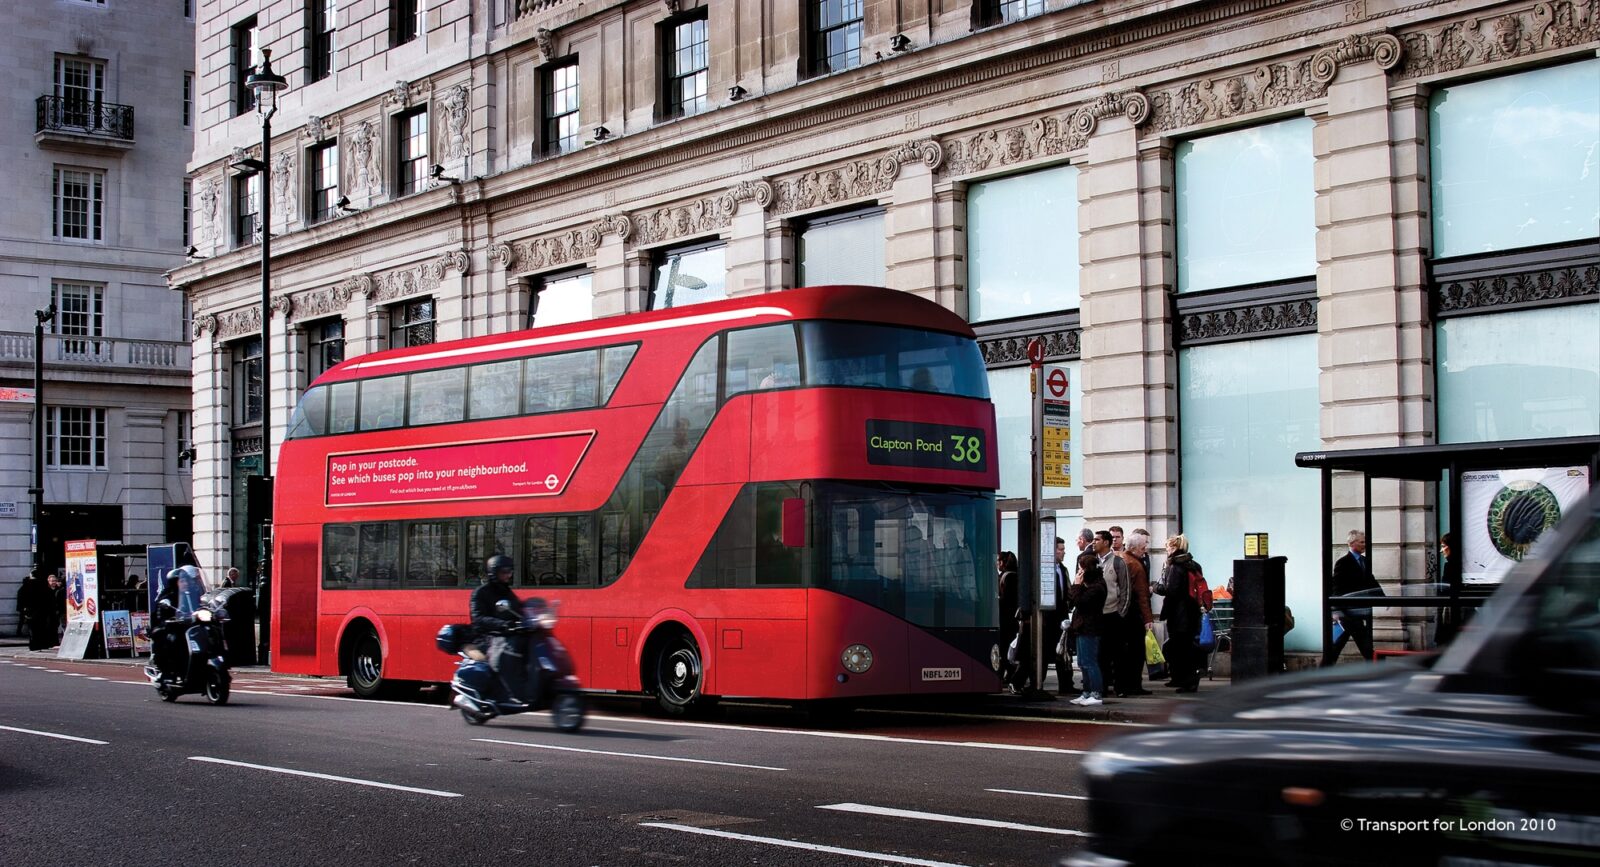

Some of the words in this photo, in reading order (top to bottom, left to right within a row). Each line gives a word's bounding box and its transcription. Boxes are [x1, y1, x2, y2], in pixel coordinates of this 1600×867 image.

[1034, 344, 1041, 360] J
[870, 436, 912, 452] Clapton
[916, 439, 943, 452] Pond
[950, 435, 981, 464] 38
[332, 462, 347, 474] Pop
[348, 461, 356, 470] in
[358, 461, 376, 472] your
[378, 456, 418, 470] postcode.
[332, 475, 346, 485] See
[348, 473, 370, 484] which
[372, 472, 396, 482] buses
[398, 472, 414, 483] pop
[416, 470, 434, 479] into
[436, 470, 456, 480] your
[458, 462, 528, 478] neighbourhood.
[923, 670, 943, 678] NBFL
[944, 670, 960, 678] 2011
